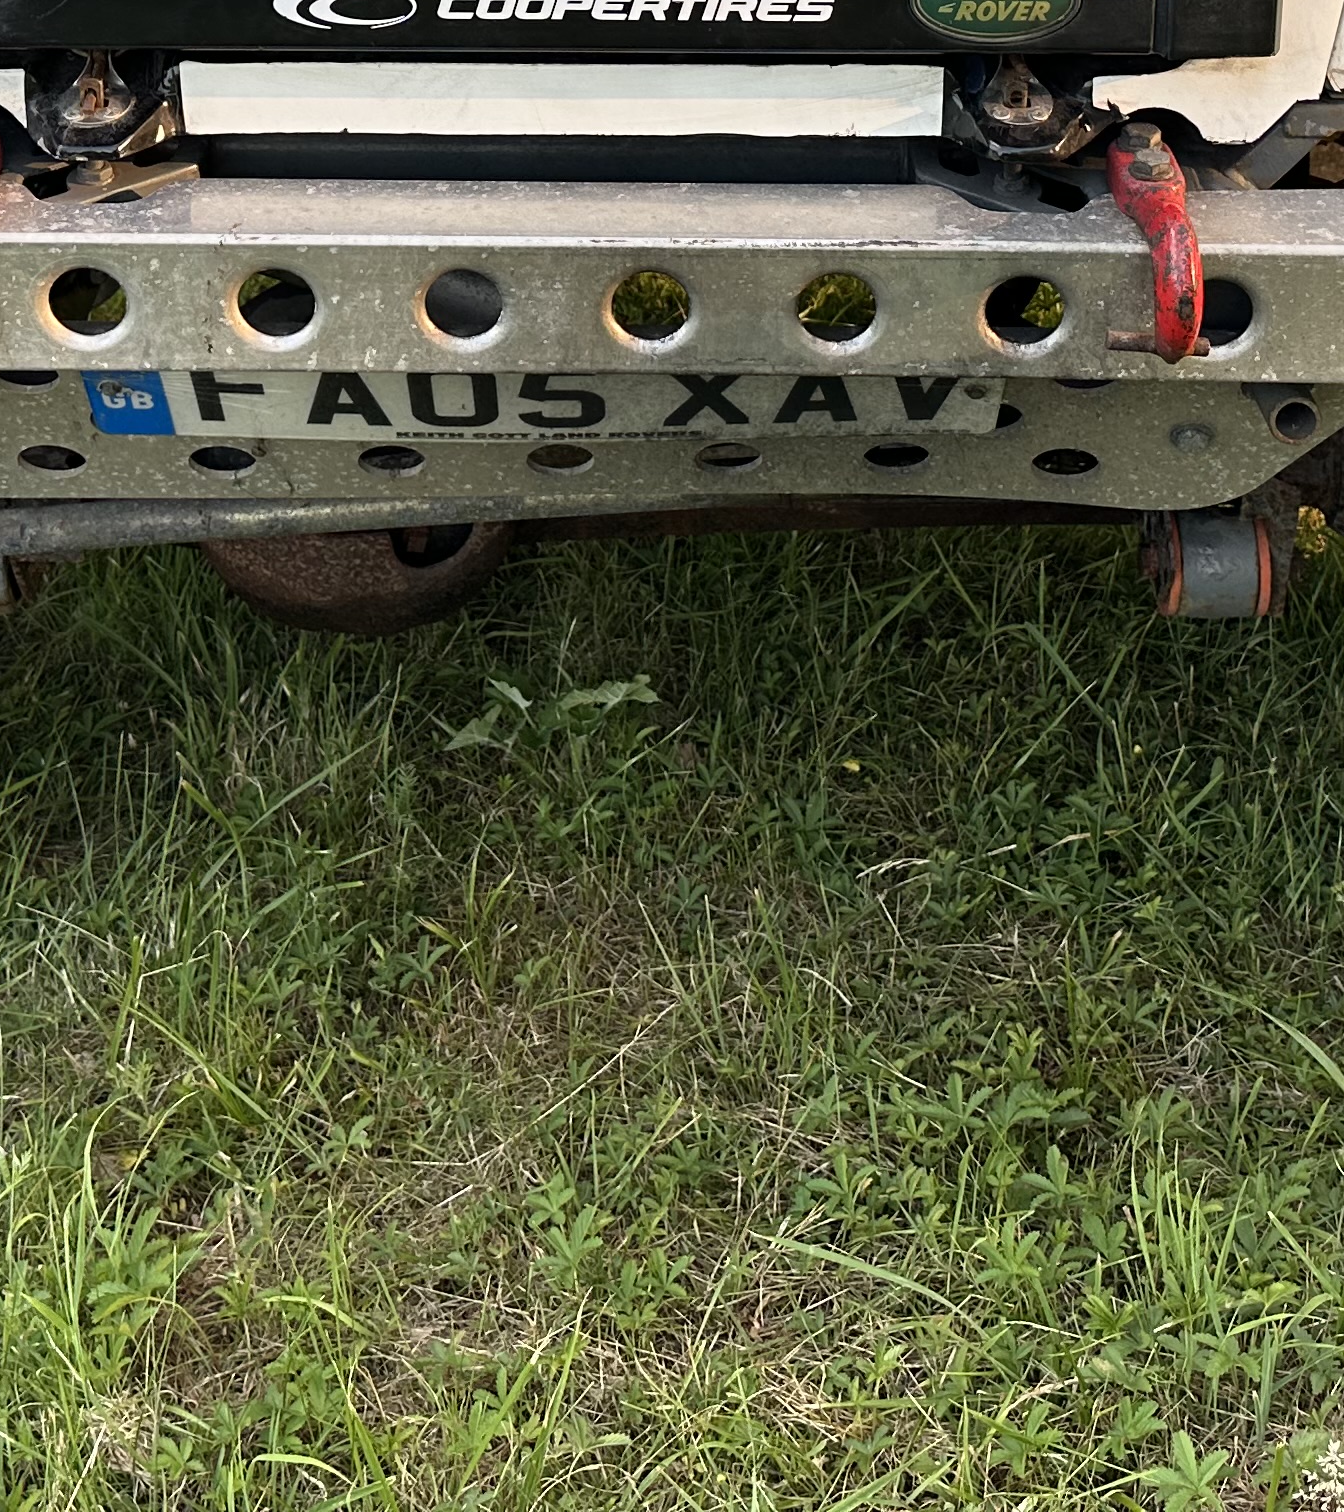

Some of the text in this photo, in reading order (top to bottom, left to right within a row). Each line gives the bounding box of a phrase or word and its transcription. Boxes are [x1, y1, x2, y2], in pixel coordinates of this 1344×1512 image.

[954, 0, 1051, 22] ROVER
[101, 387, 155, 410] GB
[539, 432, 601, 440] LAND
